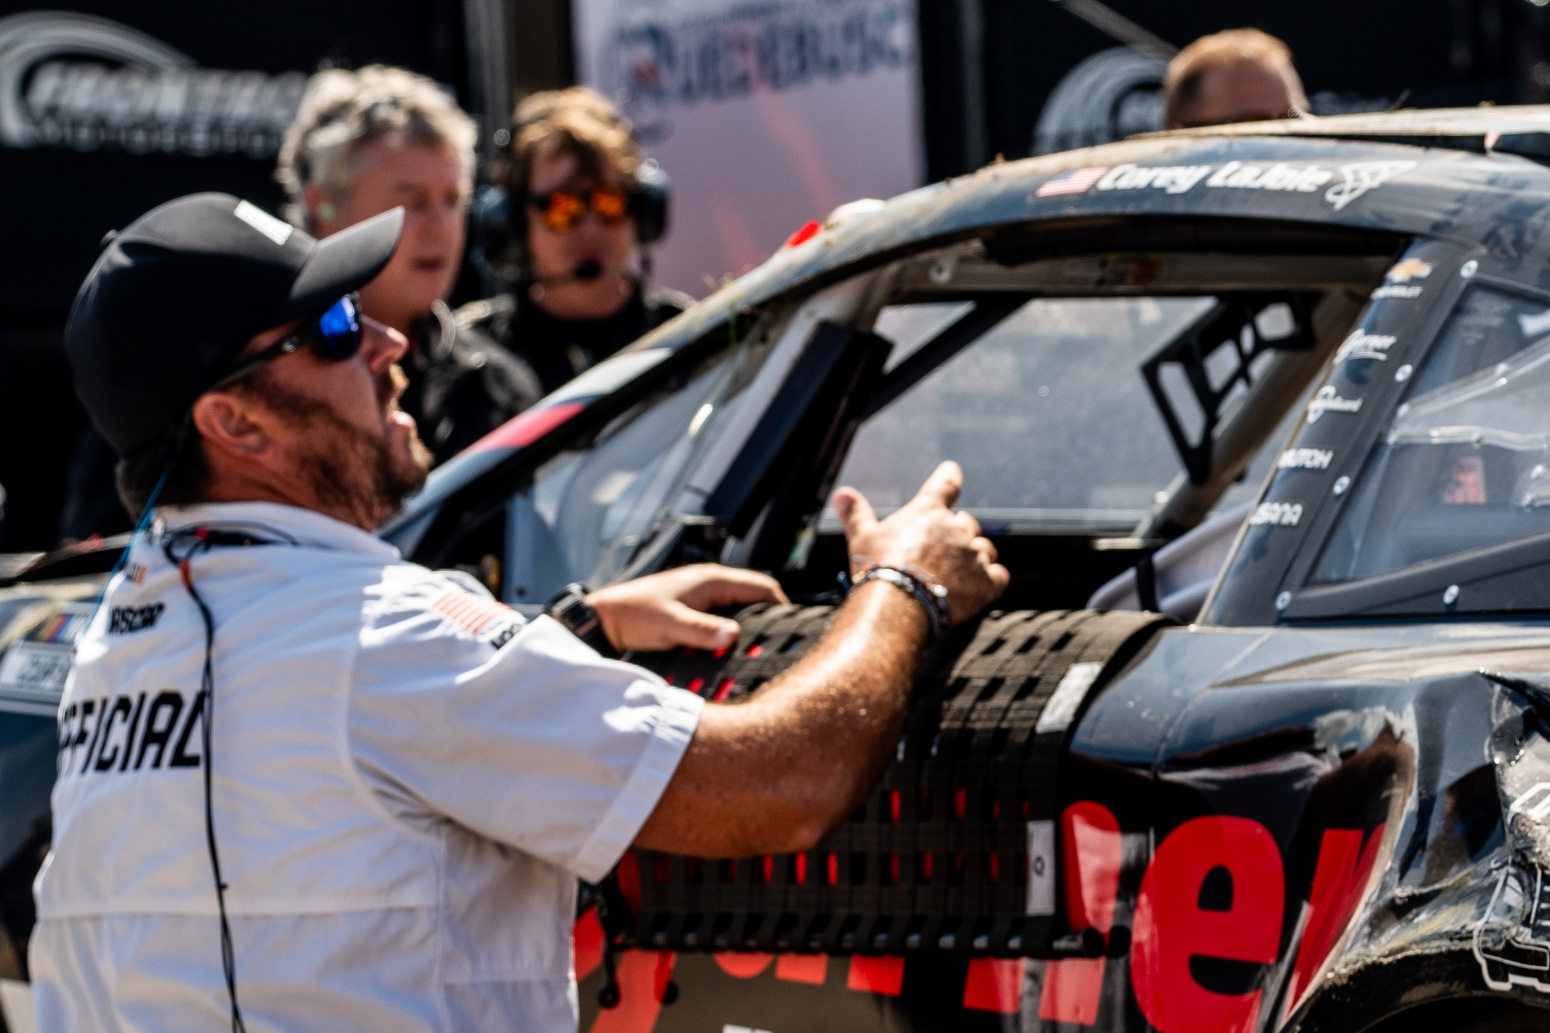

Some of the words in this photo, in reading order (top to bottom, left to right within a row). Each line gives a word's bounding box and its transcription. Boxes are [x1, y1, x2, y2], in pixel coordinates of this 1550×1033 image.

[1096, 163, 1211, 194] Corey
[1206, 160, 1334, 193] LaJoie
[57, 689, 207, 776] FFICIAL
